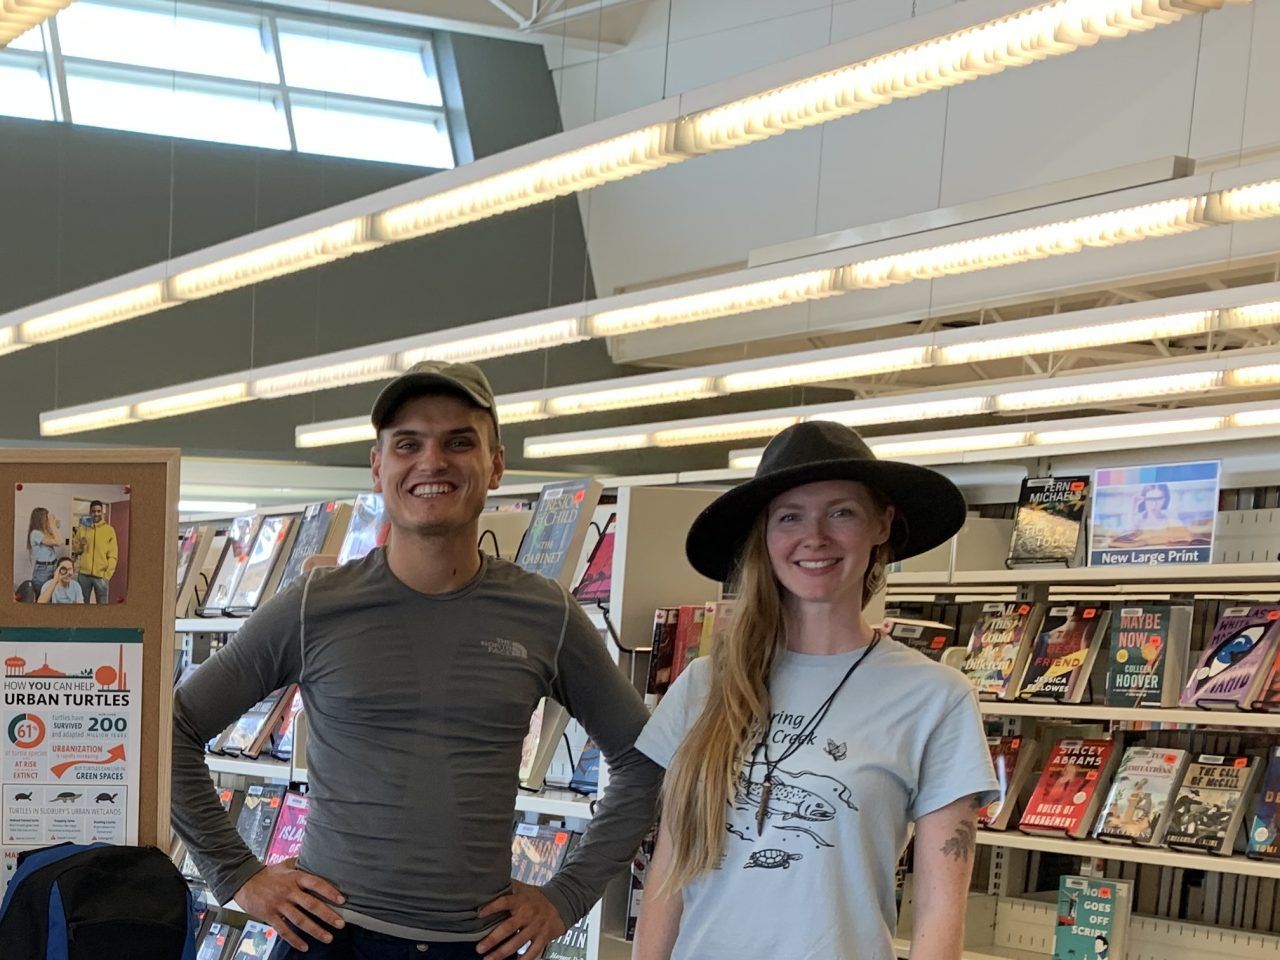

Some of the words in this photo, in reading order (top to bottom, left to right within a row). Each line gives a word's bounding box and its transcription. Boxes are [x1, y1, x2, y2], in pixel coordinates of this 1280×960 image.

[1044, 481, 1070, 492] FERN
[1029, 490, 1082, 503] MICHAELS
[522, 552, 563, 565] CABINET
[1101, 553, 1129, 564] New
[1131, 551, 1166, 566] Large
[1168, 550, 1199, 562] Print
[990, 619, 1013, 629] This
[1121, 613, 1162, 629] MAYBE
[981, 631, 1013, 645] Could
[1119, 632, 1147, 647] NOW
[965, 657, 1009, 671] Different
[1034, 657, 1080, 668] FRIEND
[4, 681, 27, 690] HOW
[29, 681, 51, 690] YOU
[53, 682, 74, 691] CAN
[74, 682, 95, 691] HELP
[1116, 675, 1158, 689] HOOVER
[4, 693, 59, 706] URBAN
[63, 694, 130, 707] TURTLES
[53, 722, 83, 730] SURVIVED
[87, 717, 128, 732] 200
[772, 730, 817, 745] Creek
[52, 745, 103, 753] URBANIZATION
[1059, 746, 1105, 755] STACEY
[1052, 756, 1102, 766] ABRAMS
[1199, 767, 1217, 777] THE
[1219, 768, 1240, 777] CALL
[1190, 777, 1204, 786] OF
[1036, 803, 1061, 814] RULES
[1063, 805, 1075, 814] OF
[1024, 815, 1077, 827] ENGAGEMENT
[279, 826, 305, 842] ISLA
[1083, 900, 1111, 912] GOES
[1089, 915, 1109, 926] OFF
[1072, 925, 1108, 937] SCRIPT
